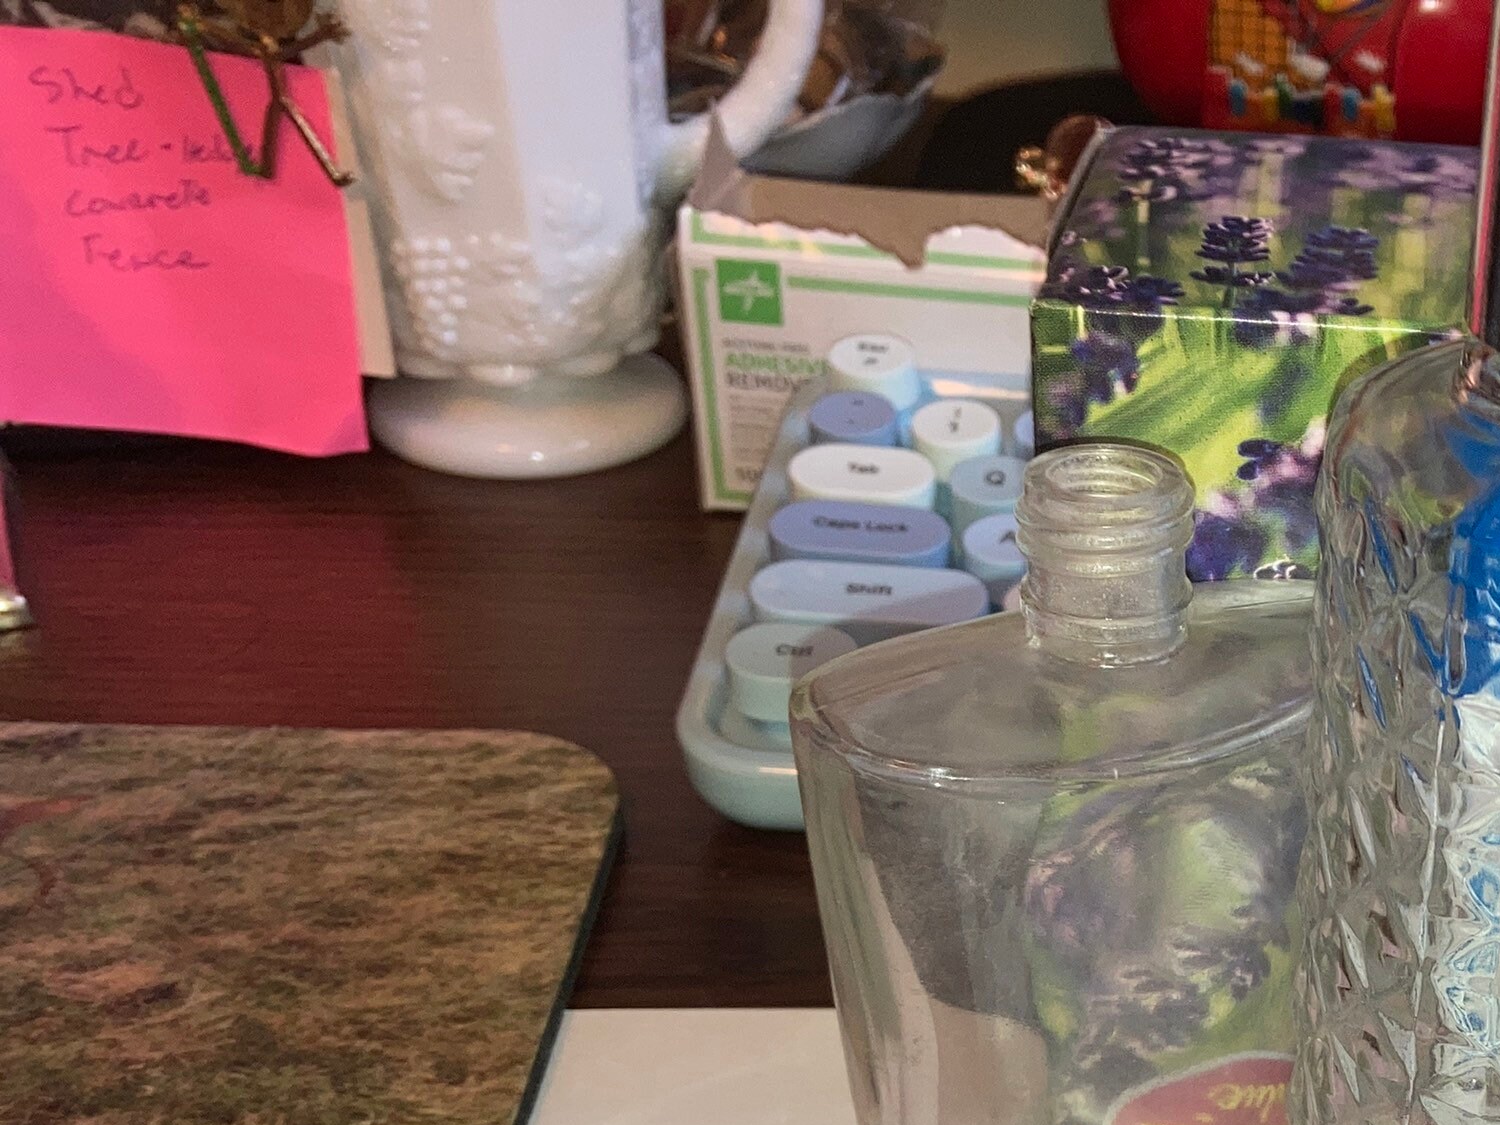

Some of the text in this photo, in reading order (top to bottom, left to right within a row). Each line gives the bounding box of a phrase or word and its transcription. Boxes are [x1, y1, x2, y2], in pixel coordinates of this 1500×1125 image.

[28, 65, 145, 110] Shed
[45, 125, 146, 166] Tree
[847, 460, 880, 475] Tab
[984, 470, 1007, 487] Q
[812, 514, 908, 533] Caps Lock
[845, 581, 893, 597] Shift
